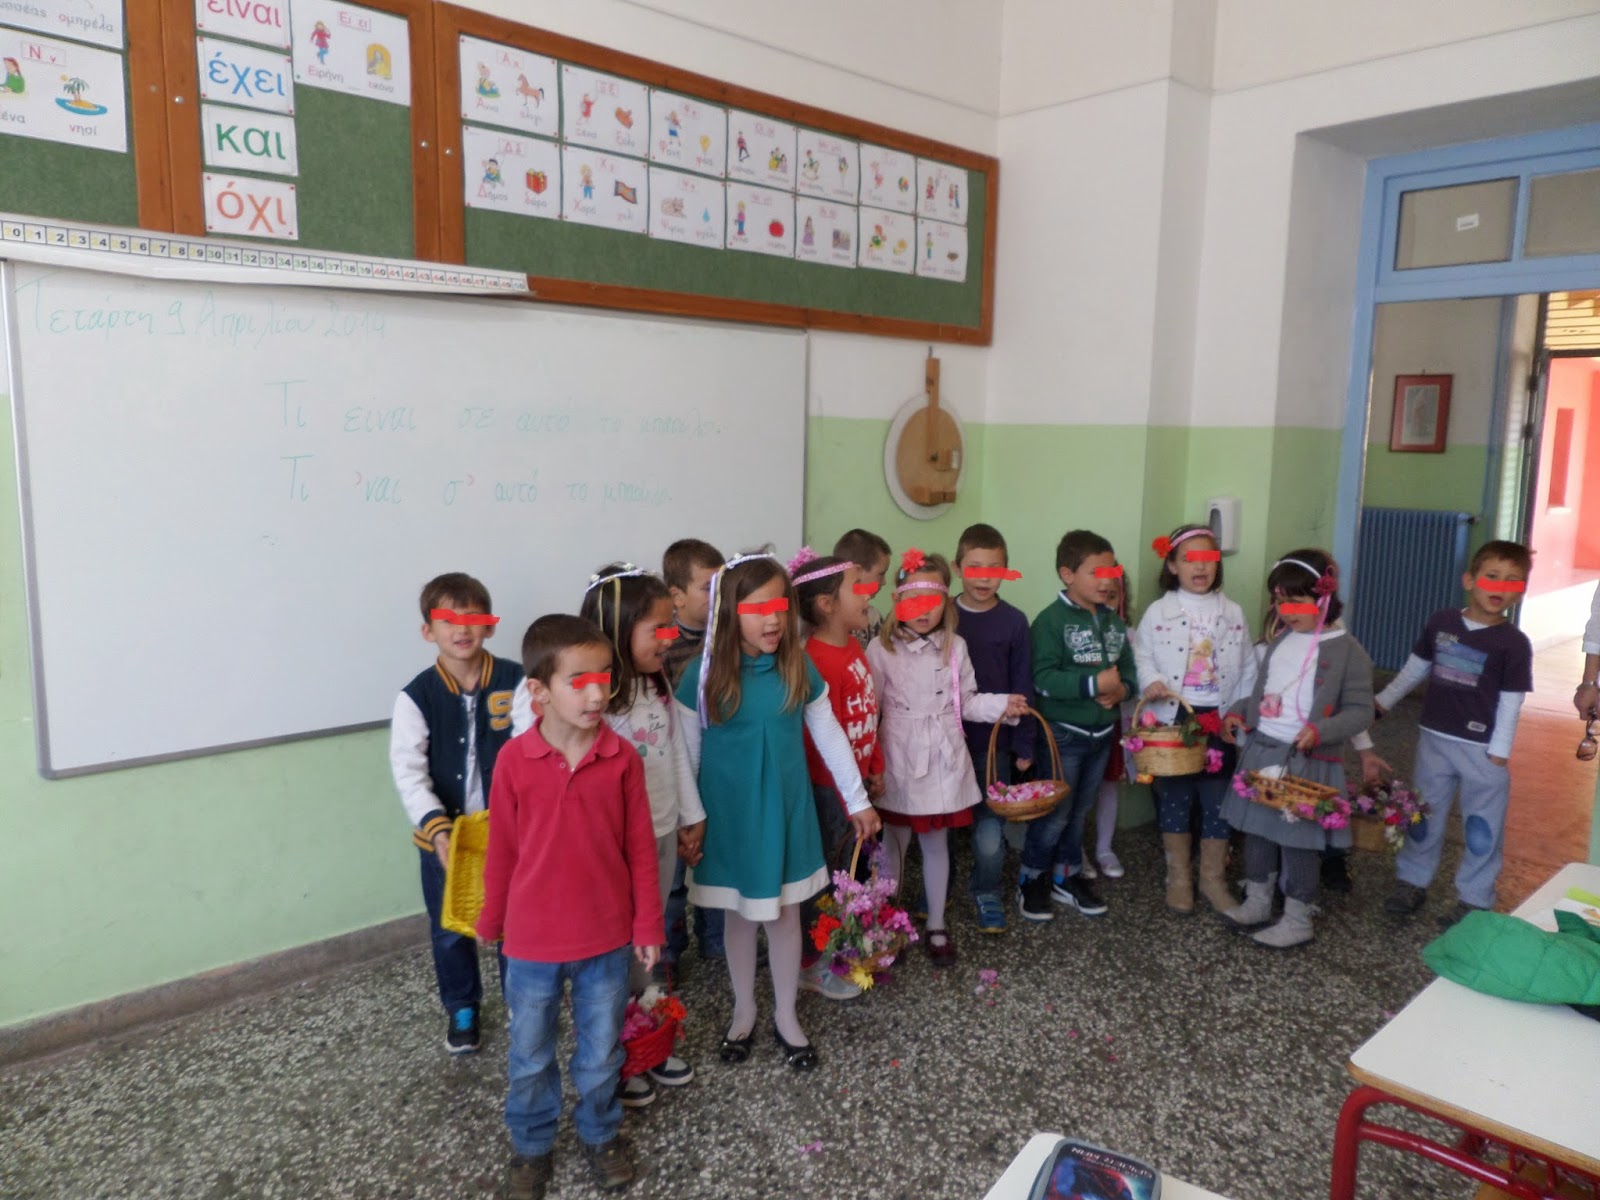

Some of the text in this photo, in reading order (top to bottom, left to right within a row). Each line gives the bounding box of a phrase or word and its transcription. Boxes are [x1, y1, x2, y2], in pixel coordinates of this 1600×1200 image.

[58, 13, 114, 32] ομπρέλα
[208, 52, 286, 97] έχει
[0, 110, 27, 124] ένα
[215, 123, 287, 160] και
[216, 181, 287, 234] όχι
[208, 249, 222, 259] 30
[225, 250, 239, 260] 31
[243, 253, 257, 263] 32
[261, 255, 274, 265] 33
[278, 257, 291, 267] 34
[295, 258, 307, 268] 35
[311, 261, 324, 270] 36
[327, 262, 339, 271] 37
[14, 271, 156, 340] Τετάρτη
[167, 299, 187, 335] 9
[264, 380, 309, 430] Τι
[457, 406, 496, 433] σε
[280, 454, 314, 503] Τι
[494, 467, 540, 503] αυτό
[566, 482, 589, 502] το
